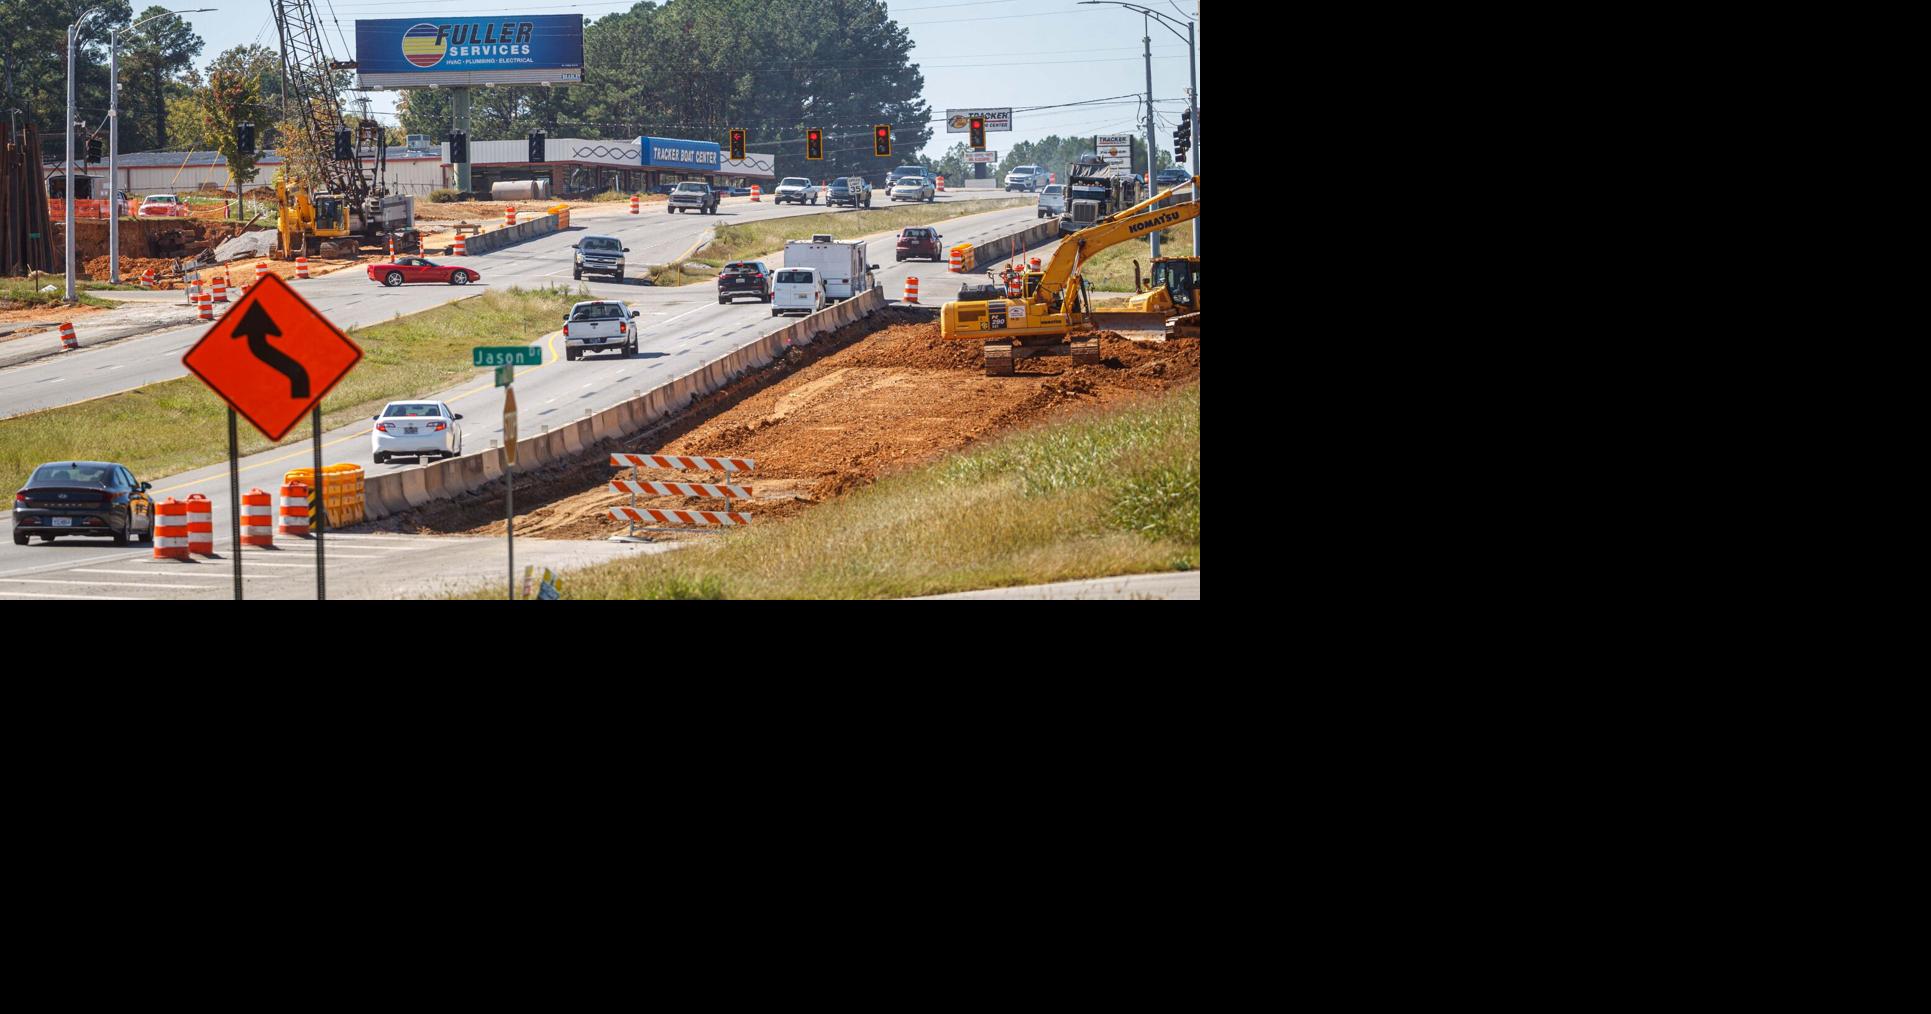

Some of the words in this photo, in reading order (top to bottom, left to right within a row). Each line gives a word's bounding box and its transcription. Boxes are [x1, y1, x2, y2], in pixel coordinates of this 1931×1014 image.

[435, 22, 533, 46] FULLER
[450, 45, 530, 56] SERVICES
[653, 147, 679, 161] TRACKER
[681, 150, 694, 162] BOAT
[696, 151, 717, 164] CENTER
[1128, 211, 1180, 233] KOMATSU
[475, 350, 524, 364] Jason
